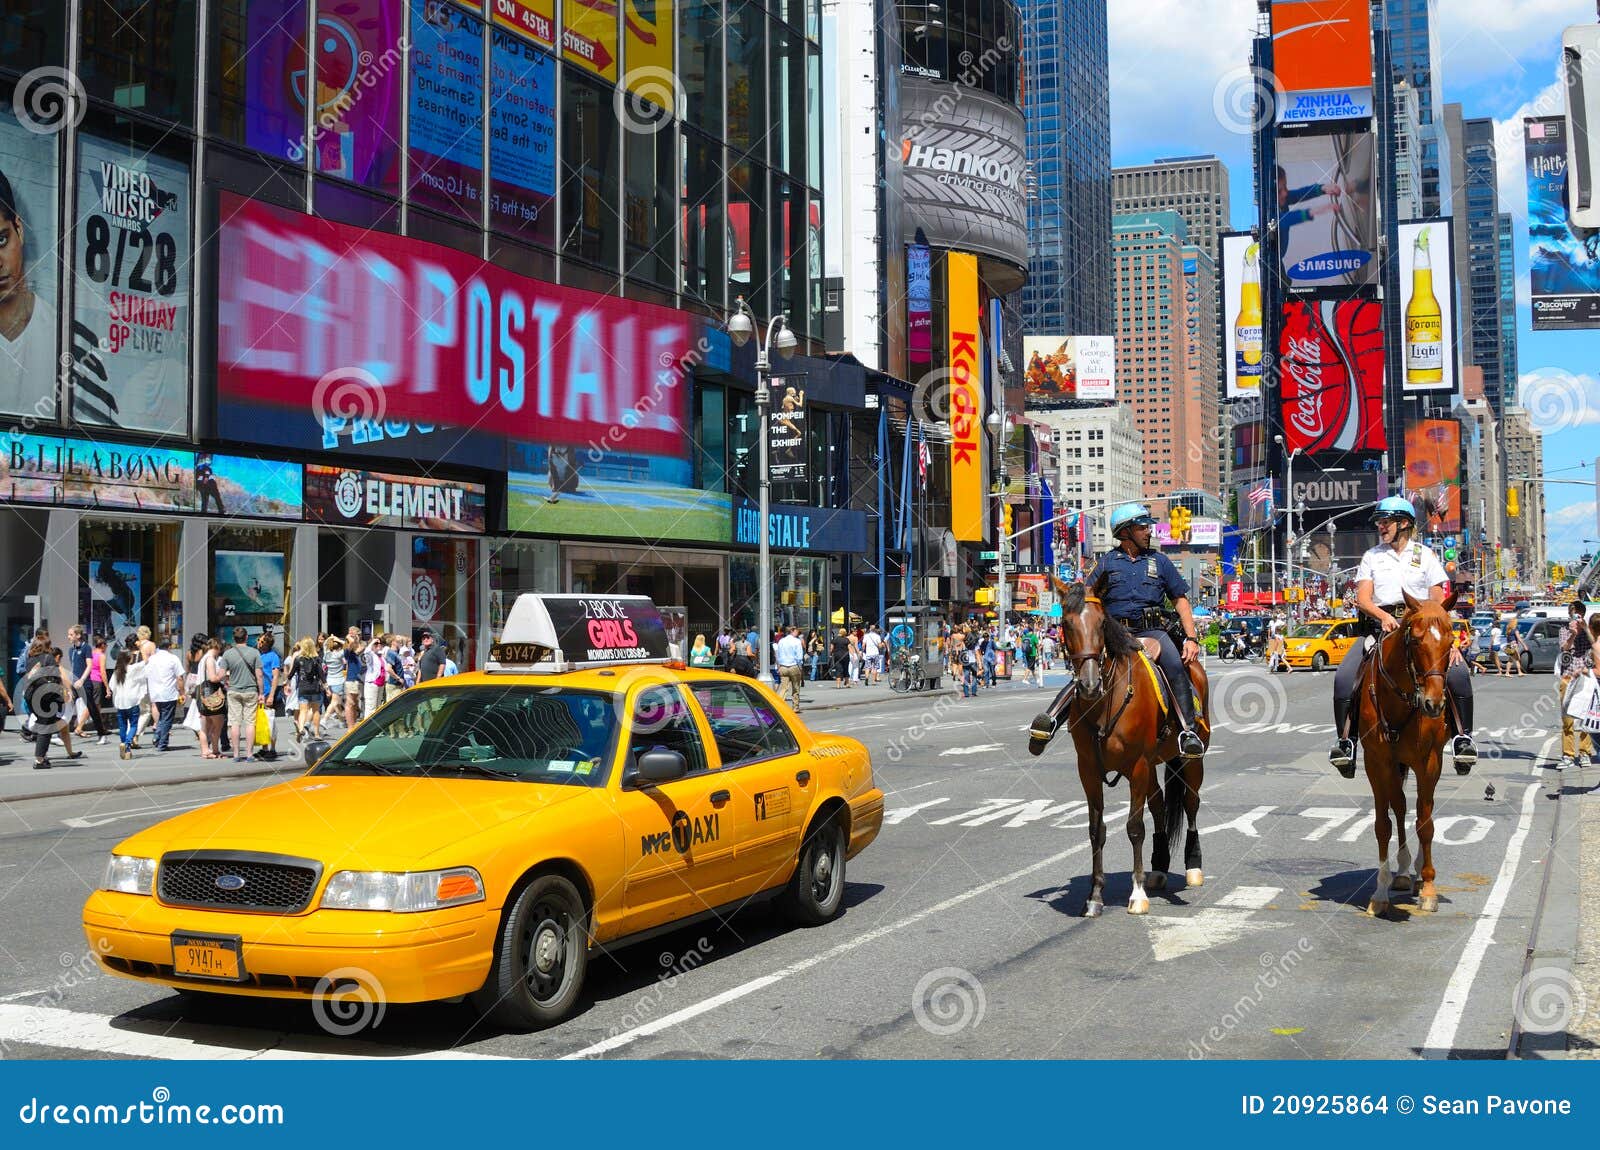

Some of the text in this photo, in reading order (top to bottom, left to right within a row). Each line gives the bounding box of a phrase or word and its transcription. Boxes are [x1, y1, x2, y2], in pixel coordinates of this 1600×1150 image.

[497, 0, 595, 60] ON 45TH STREET
[1296, 93, 1352, 108] XINHUA
[1284, 105, 1366, 119] NEWS AGENCY
[908, 144, 1020, 190] Hankook
[1532, 153, 1567, 178] Harry
[101, 161, 150, 198] VIDEO
[937, 173, 986, 191] driving
[103, 187, 155, 223] MUSIC
[112, 216, 141, 232] AWARDS
[85, 214, 177, 296] 8/28
[1298, 259, 1361, 271] SAMSUNG
[110, 291, 176, 331] SUNDAY
[1238, 327, 1263, 337] Coron
[1409, 319, 1440, 331] Corona
[133, 328, 162, 353] LIVE
[1411, 344, 1440, 358] Light
[1288, 335, 1323, 437] Coca-Cola
[952, 331, 977, 467] Kodak
[771, 411, 804, 420] POMPEII
[771, 426, 787, 434] THE
[771, 438, 802, 447] EXHIBIT
[366, 479, 463, 520] ELEMENT
[1292, 480, 1361, 502] COUNT
[579, 600, 628, 619] 2 BROKE
[588, 618, 638, 648] GIRLS
[505, 646, 537, 660] 9Y47
[587, 649, 614, 660] MONDAYS
[641, 831, 671, 857] NYC
[188, 948, 214, 969] 9Y47
